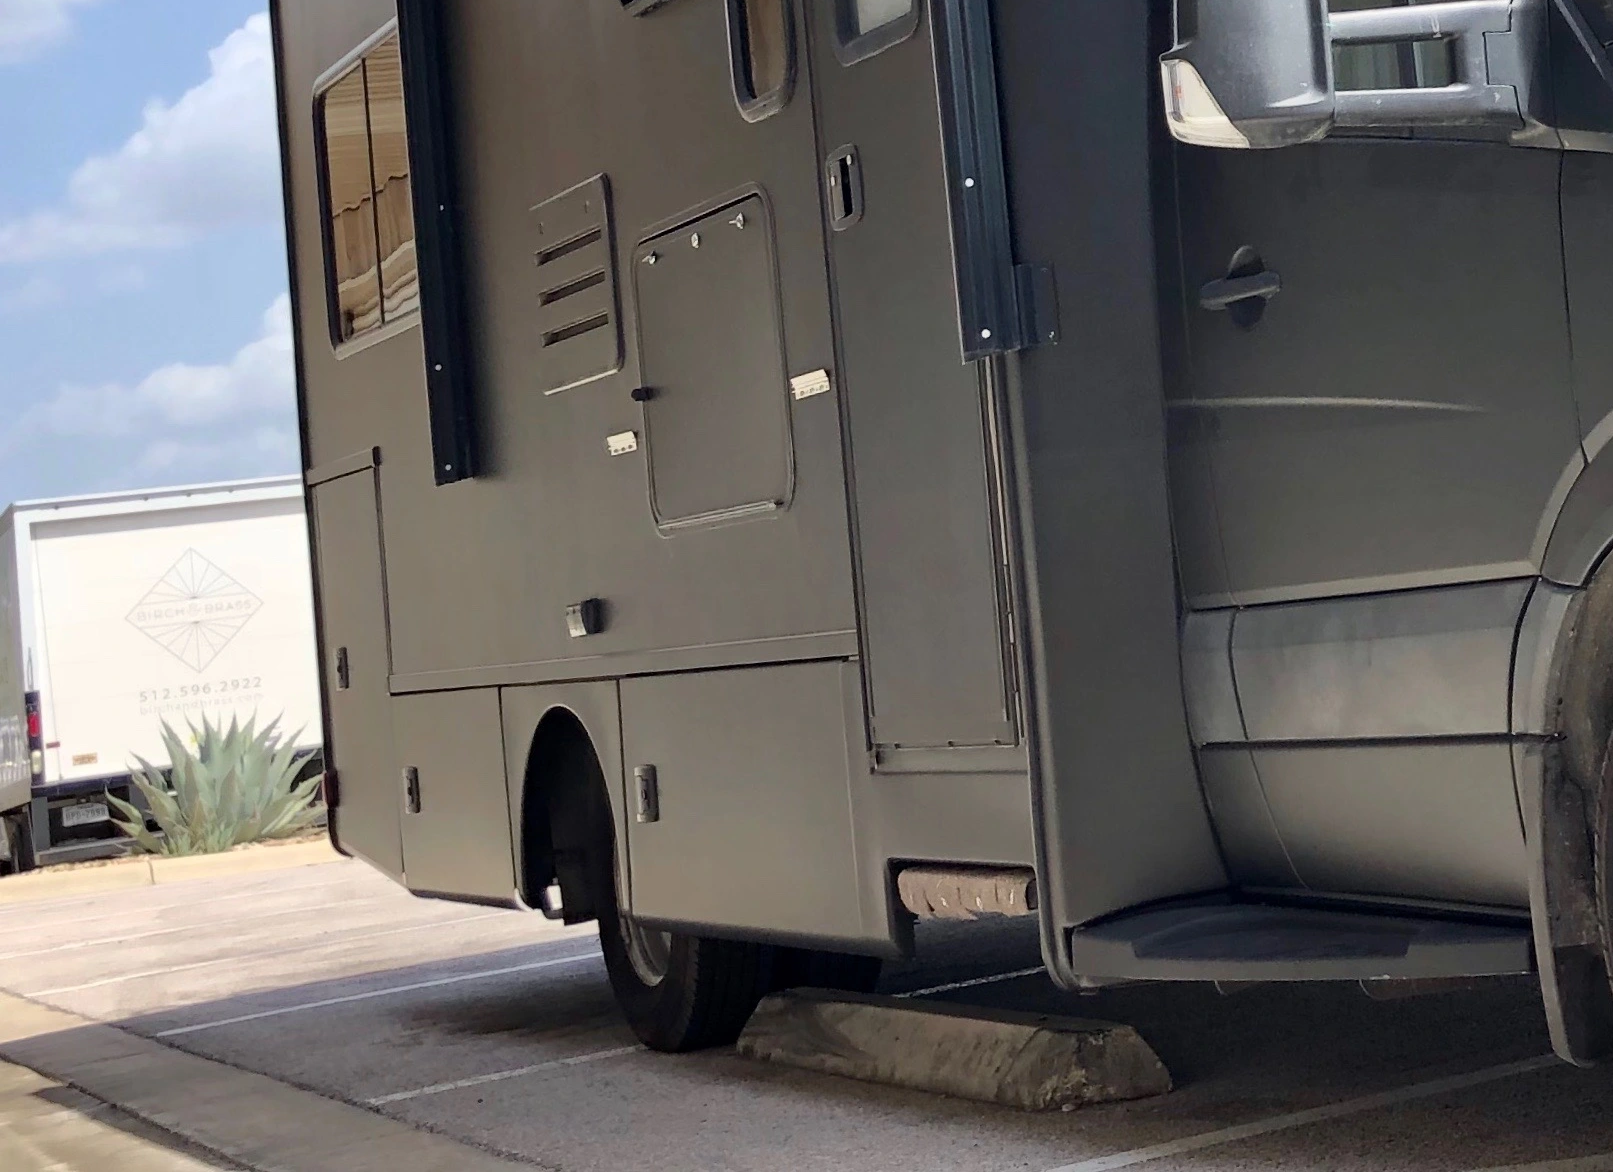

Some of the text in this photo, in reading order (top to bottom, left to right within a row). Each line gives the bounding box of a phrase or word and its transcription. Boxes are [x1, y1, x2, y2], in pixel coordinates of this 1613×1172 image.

[137, 608, 185, 622] BIRCH
[204, 599, 252, 614] BRASS
[139, 676, 262, 702] 512.596.2922
